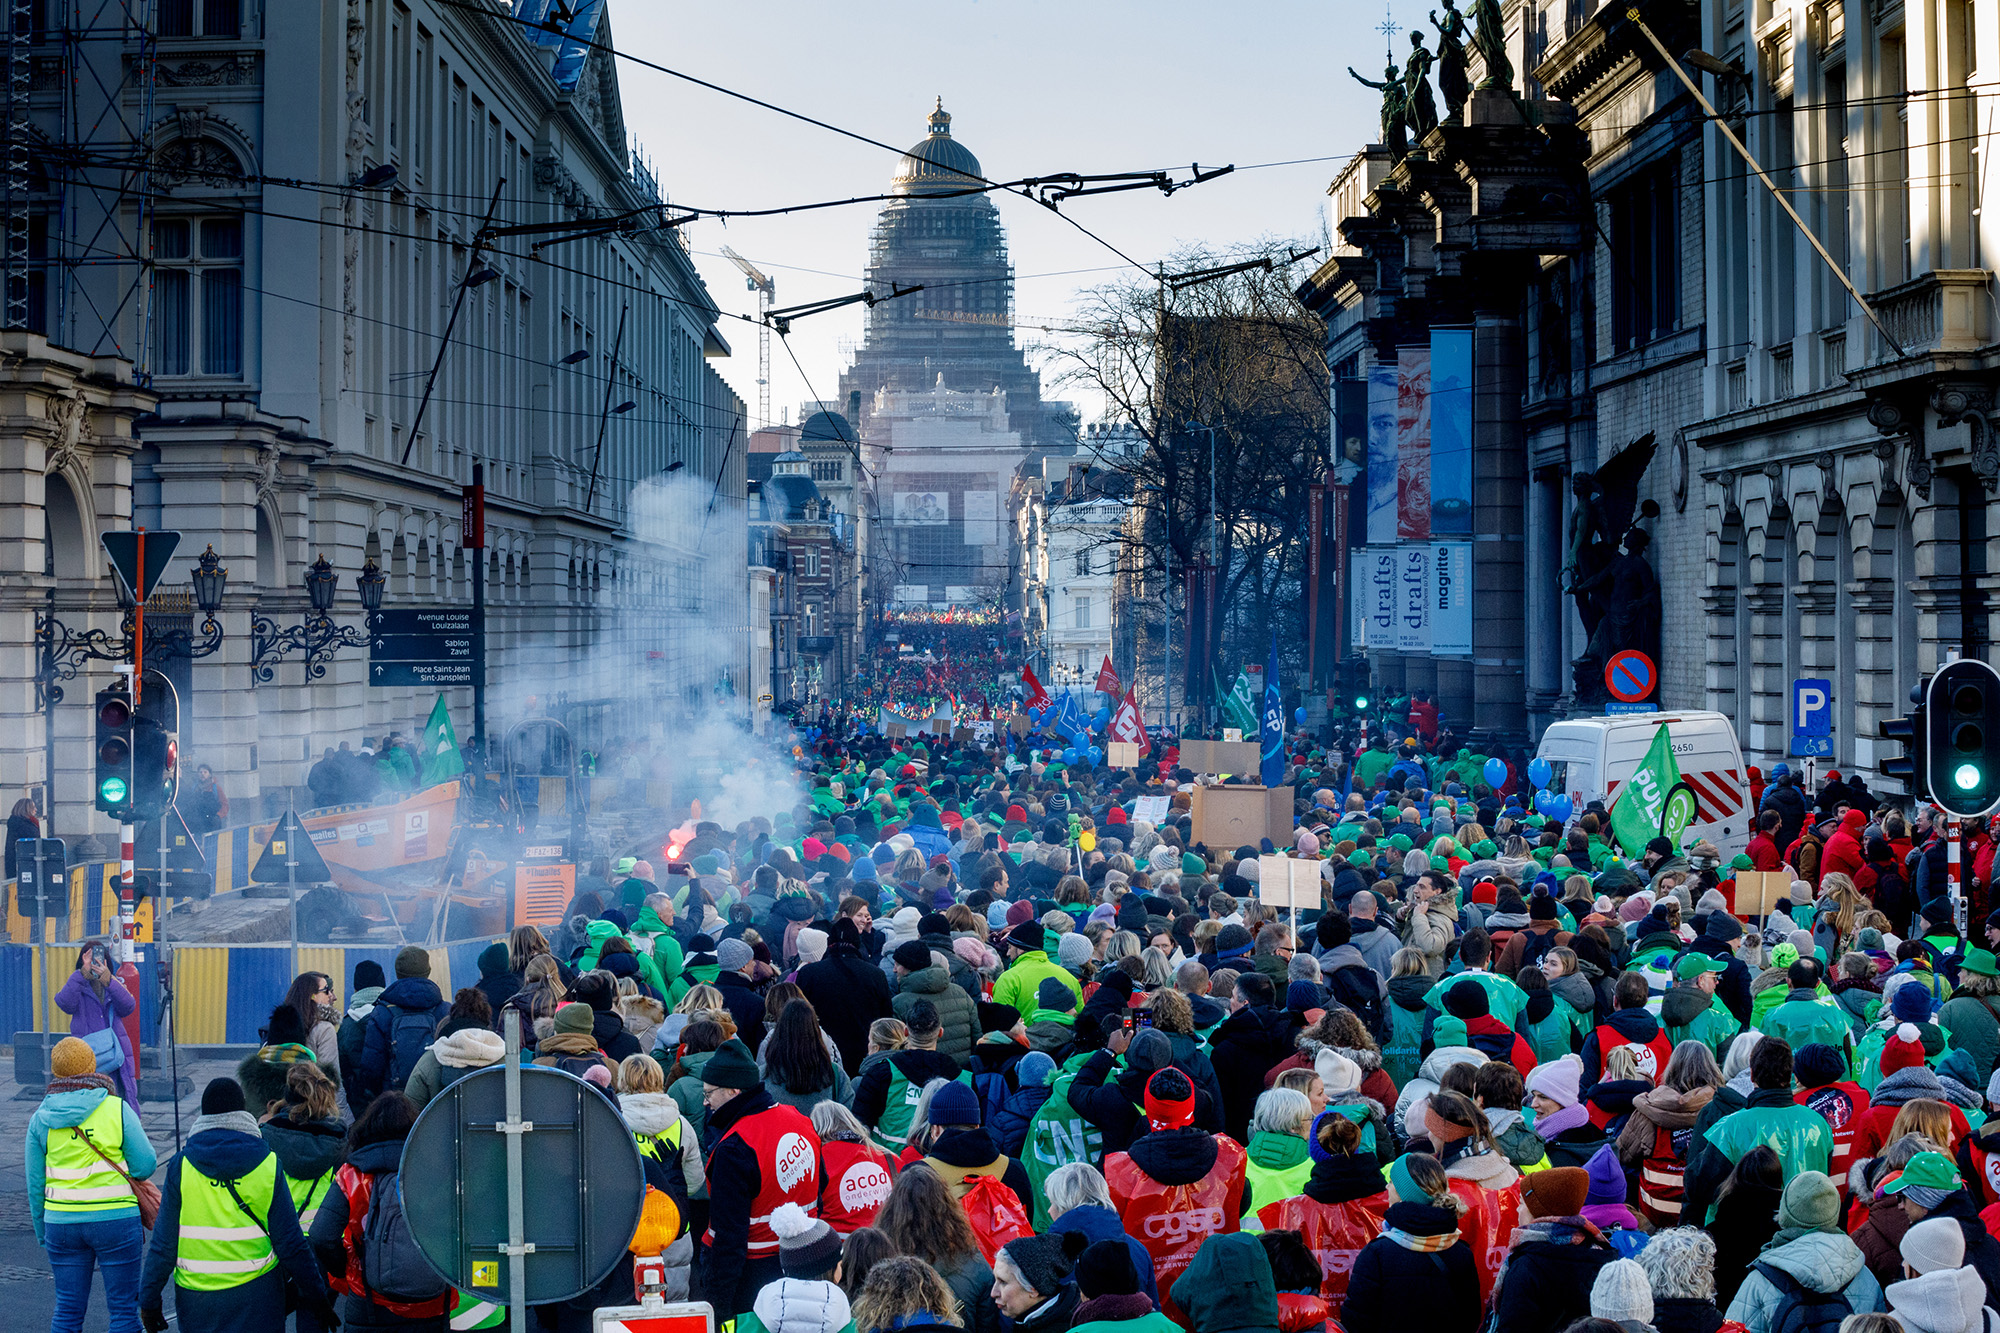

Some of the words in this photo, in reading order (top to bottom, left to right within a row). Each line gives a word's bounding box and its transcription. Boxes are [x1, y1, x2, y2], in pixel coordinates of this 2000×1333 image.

[1422, 579, 1429, 588] to
[1435, 547, 1451, 610] magritte
[1454, 547, 1465, 606] museum
[1373, 555, 1391, 628] drafts
[1403, 552, 1422, 629] drafts
[1422, 588, 1430, 610] Rubens
[417, 613, 445, 621] Avenue
[446, 613, 470, 621] Louise
[444, 639, 470, 647] Sablon
[450, 648, 470, 656] Zavel
[412, 665, 433, 673] Place
[433, 665, 470, 673] Saint-Jean
[420, 674, 471, 682] Sint-Jansplein
[1799, 688, 1826, 728] P
[1672, 743, 1694, 752] 2650
[1636, 1048, 1652, 1062] od
[907, 1088, 923, 1099] CN
[779, 1135, 808, 1174] acod
[781, 1150, 812, 1184] onderwijs
[844, 1170, 888, 1192] acod
[844, 1186, 890, 1201] onderwijs
[1143, 1206, 1226, 1245] cgsp
[1154, 1253, 1188, 1263] CENTRALE
[1163, 1261, 1192, 1269] SERVIC
